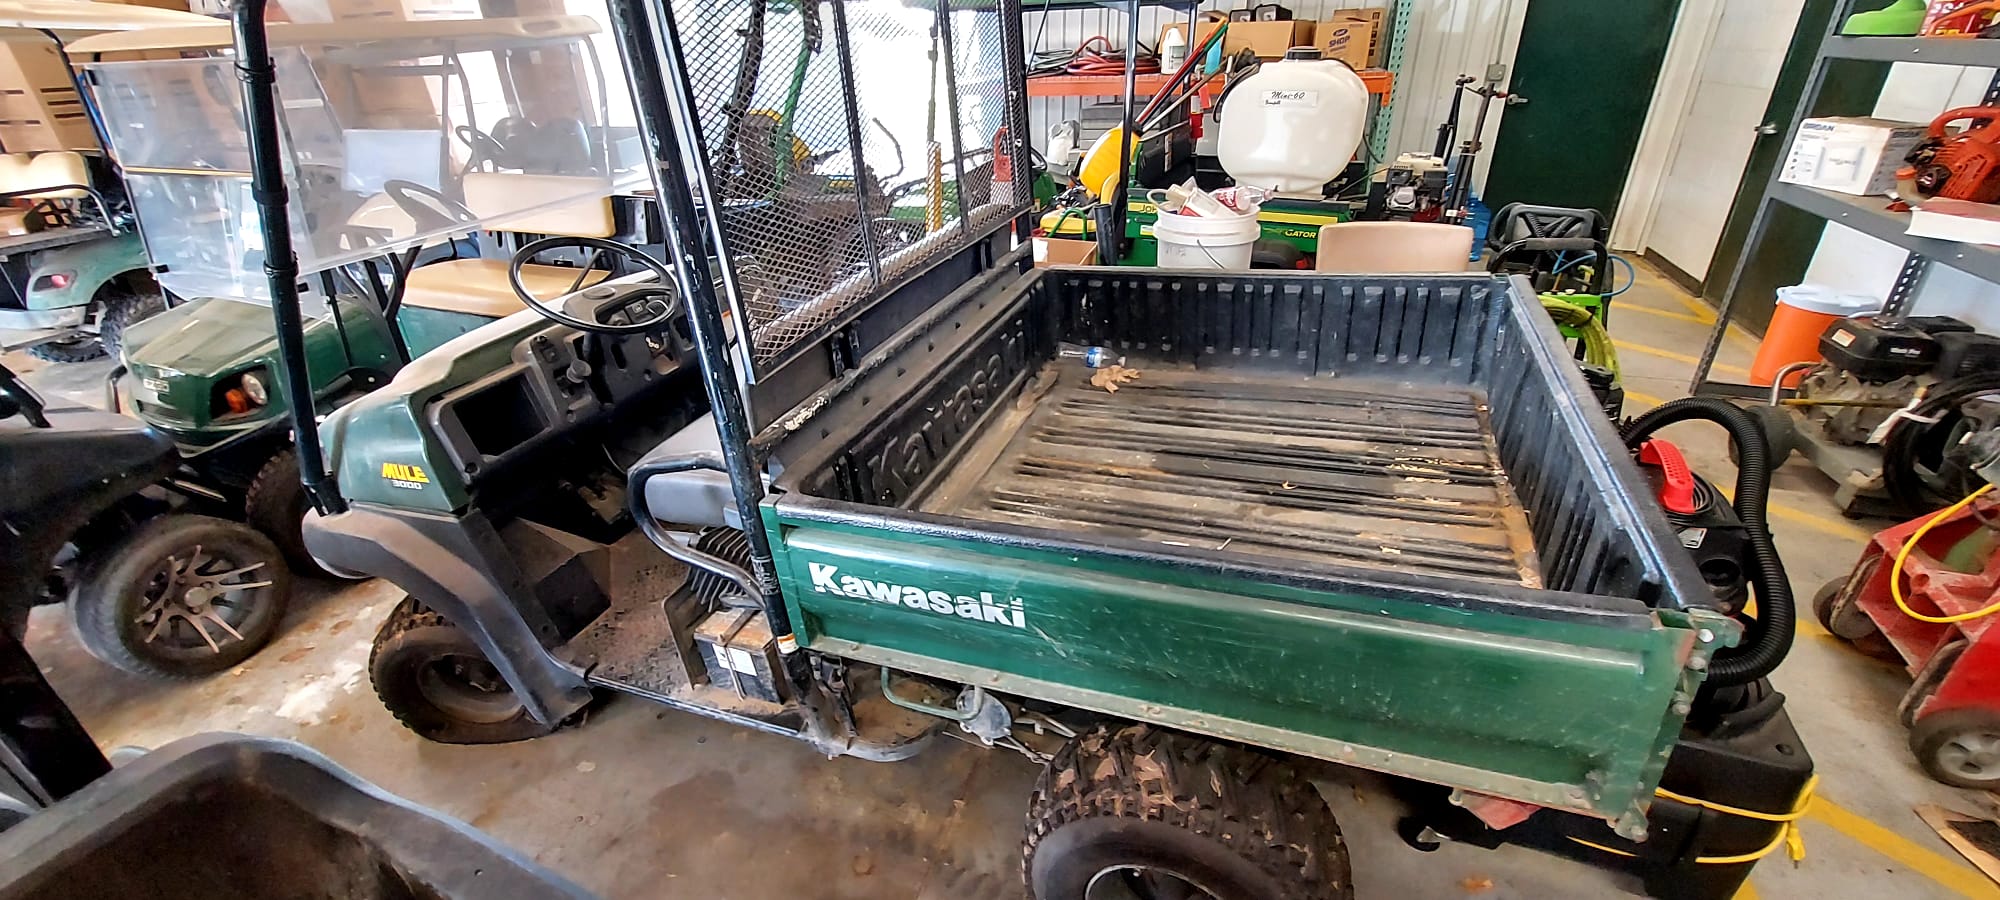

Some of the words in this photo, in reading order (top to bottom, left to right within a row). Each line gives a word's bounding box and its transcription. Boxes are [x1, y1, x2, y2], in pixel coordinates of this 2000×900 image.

[1285, 229, 1317, 239] GATOR
[867, 318, 1026, 501] Kawasaki
[382, 462, 430, 483] MULE
[391, 479, 423, 490] 3000
[808, 562, 1026, 628] Kawasaki
